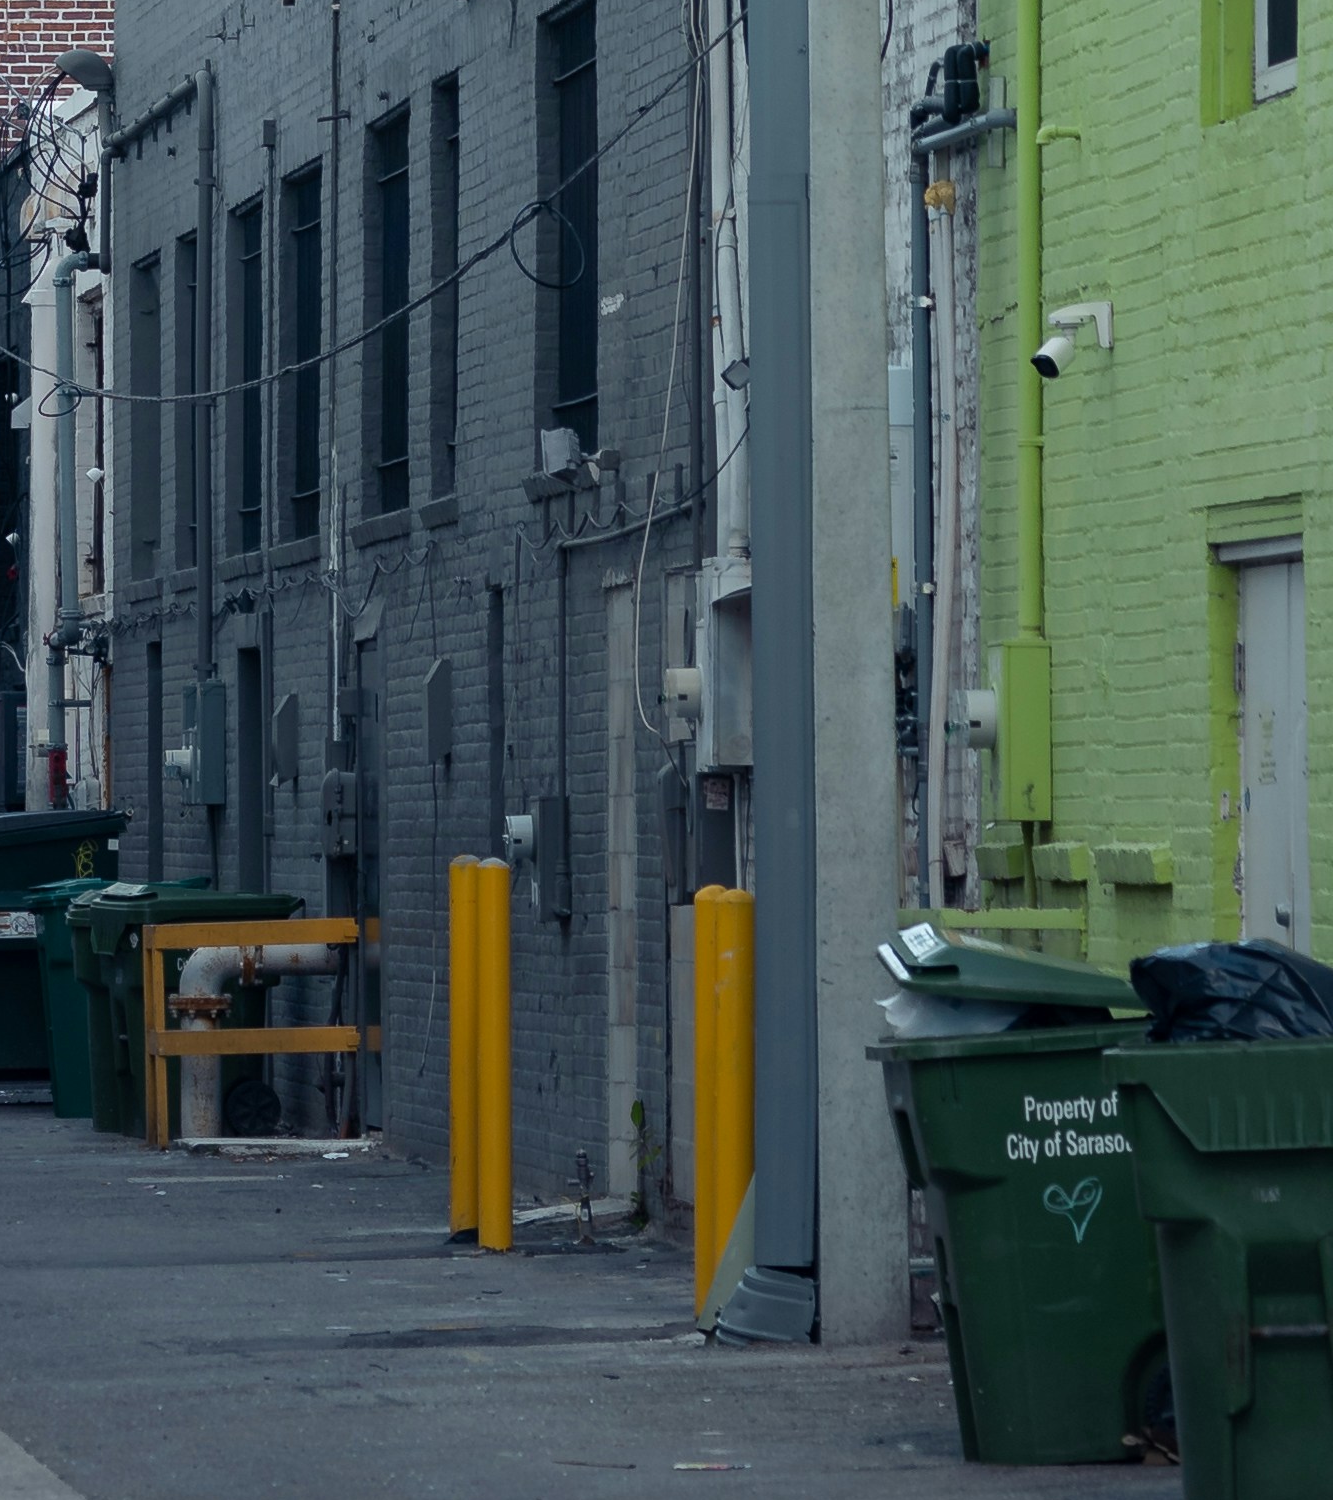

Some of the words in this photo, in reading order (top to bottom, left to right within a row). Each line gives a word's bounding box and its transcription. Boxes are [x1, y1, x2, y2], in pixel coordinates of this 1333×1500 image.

[1024, 1095, 1095, 1126] Property
[1101, 1089, 1118, 1117] of
[1007, 1132, 1039, 1164] City
[1044, 1130, 1061, 1157] of
